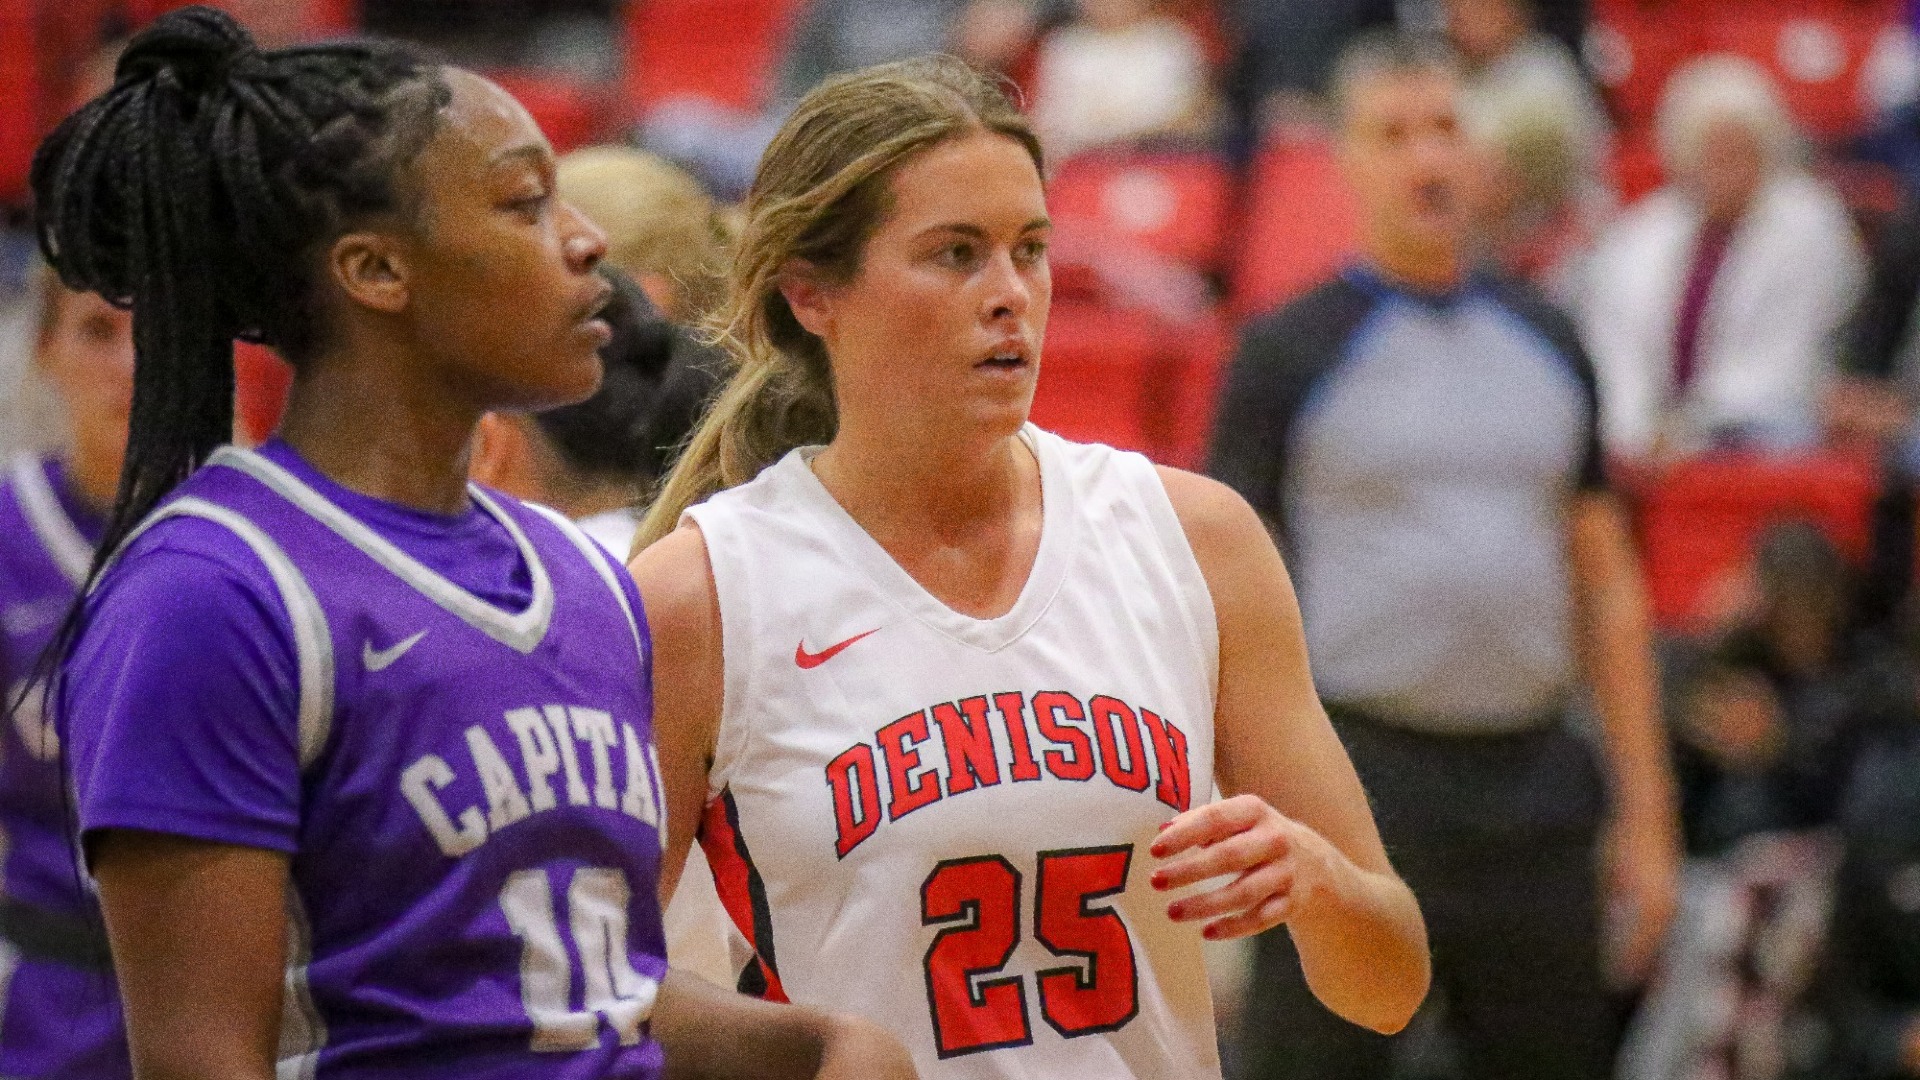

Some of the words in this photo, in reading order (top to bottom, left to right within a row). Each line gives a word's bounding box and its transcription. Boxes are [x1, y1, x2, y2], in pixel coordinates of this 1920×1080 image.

[825, 690, 1191, 861] DENISON
[500, 867, 658, 1053] 10
[920, 843, 1139, 1060] 25
